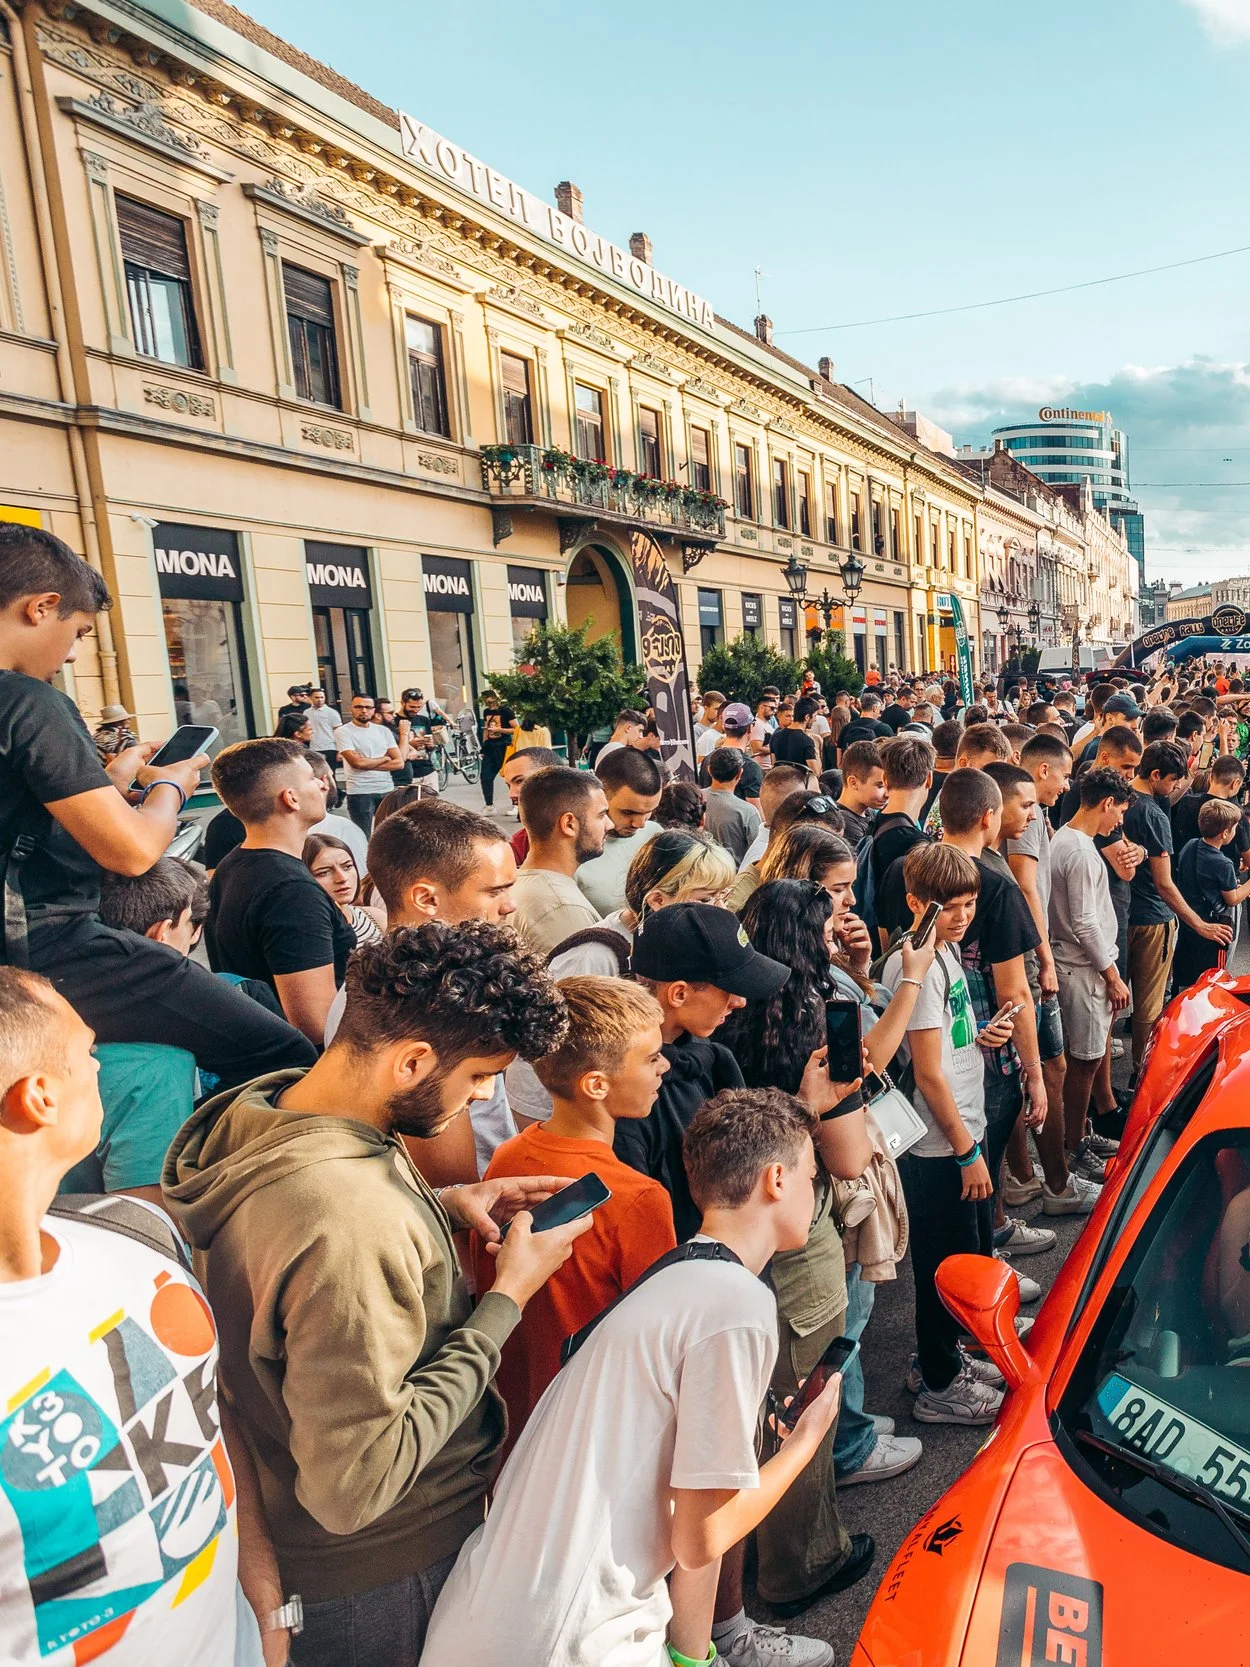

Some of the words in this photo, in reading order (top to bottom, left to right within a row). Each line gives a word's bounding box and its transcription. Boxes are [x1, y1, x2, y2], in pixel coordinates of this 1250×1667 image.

[402, 114, 530, 223] ХОТЕЛ
[548, 207, 714, 329] ВОЈВОДИНА
[1039, 407, 1104, 422] Continental
[155, 548, 236, 578] MONA
[306, 563, 366, 588] MONA
[423, 573, 470, 596] MONA
[507, 582, 544, 603] MONA
[1112, 1398, 1186, 1460] 8AD
[1045, 1590, 1089, 1667] BE
